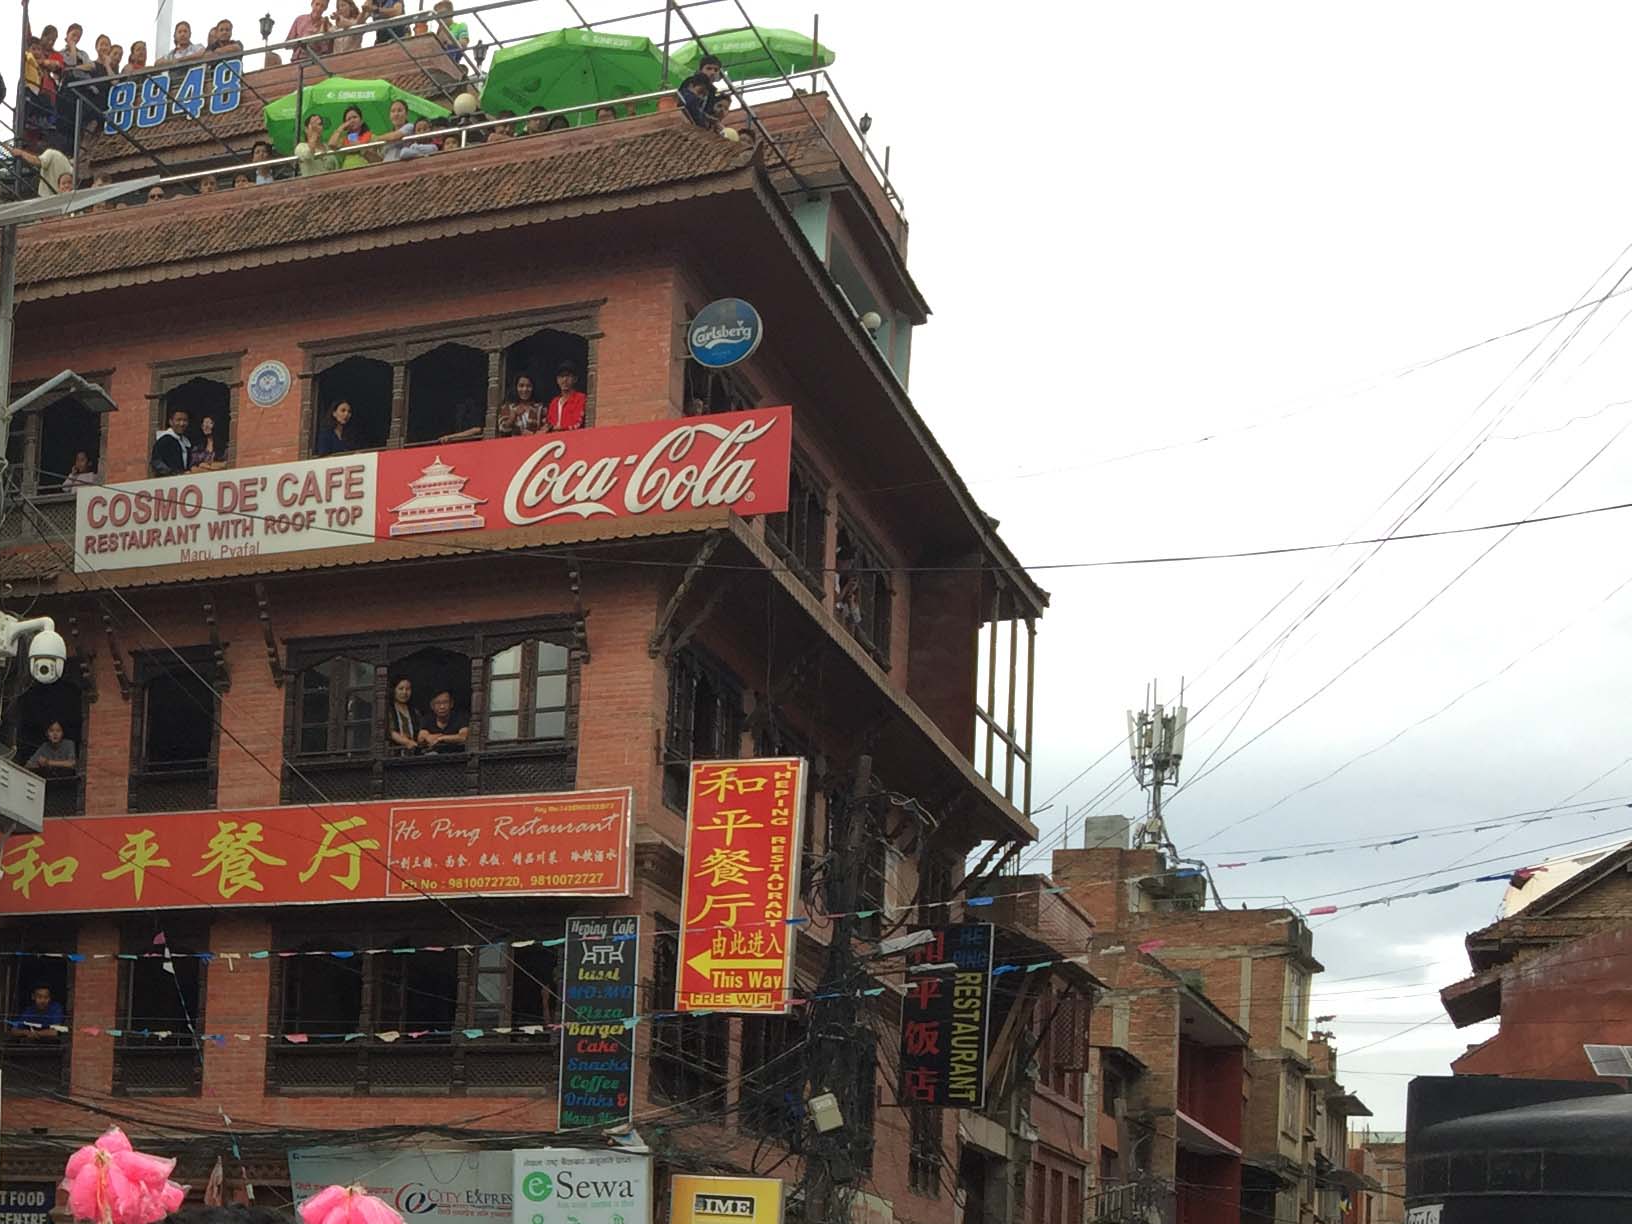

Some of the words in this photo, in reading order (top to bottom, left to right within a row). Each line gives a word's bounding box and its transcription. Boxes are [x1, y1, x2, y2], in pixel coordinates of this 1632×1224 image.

[104, 59, 243, 134] 8848
[692, 322, 752, 348] Carlsberg
[503, 415, 778, 526] Coca-Cola
[86, 484, 204, 530] COSMO
[276, 463, 366, 508] CAFE
[84, 523, 201, 556] RESTAURANT
[206, 516, 255, 546] WITH
[263, 509, 316, 536] ROOF
[324, 504, 364, 529] TOP
[770, 771, 792, 826] HEPING
[394, 819, 422, 843] He
[430, 817, 482, 847] Ping
[492, 812, 620, 841] Restaurant
[2, 814, 381, 901] 和平餐厅
[688, 767, 768, 928] 和平餐厅
[529, 872, 605, 887] 9810072727
[764, 836, 787, 928] RESTAURANT
[571, 920, 608, 939] Heping
[612, 918, 636, 935] Cafe
[711, 929, 784, 958] 由此进入
[711, 970, 744, 990] This
[748, 970, 783, 990] Way
[692, 993, 731, 1005] FREE
[736, 992, 773, 1005] WIFI
[576, 1005, 625, 1019] Pizza
[568, 1023, 625, 1039] Burger
[948, 972, 983, 1103] RESTAURANT
[576, 1040, 619, 1053] Cake
[567, 1057, 629, 1072] Snacks
[569, 1074, 621, 1094] Coffee
[564, 1091, 615, 1107] Drinks
[616, 1092, 628, 1107] &
[10, 1191, 45, 1206] FOOD
[705, 1198, 752, 1215] IME
